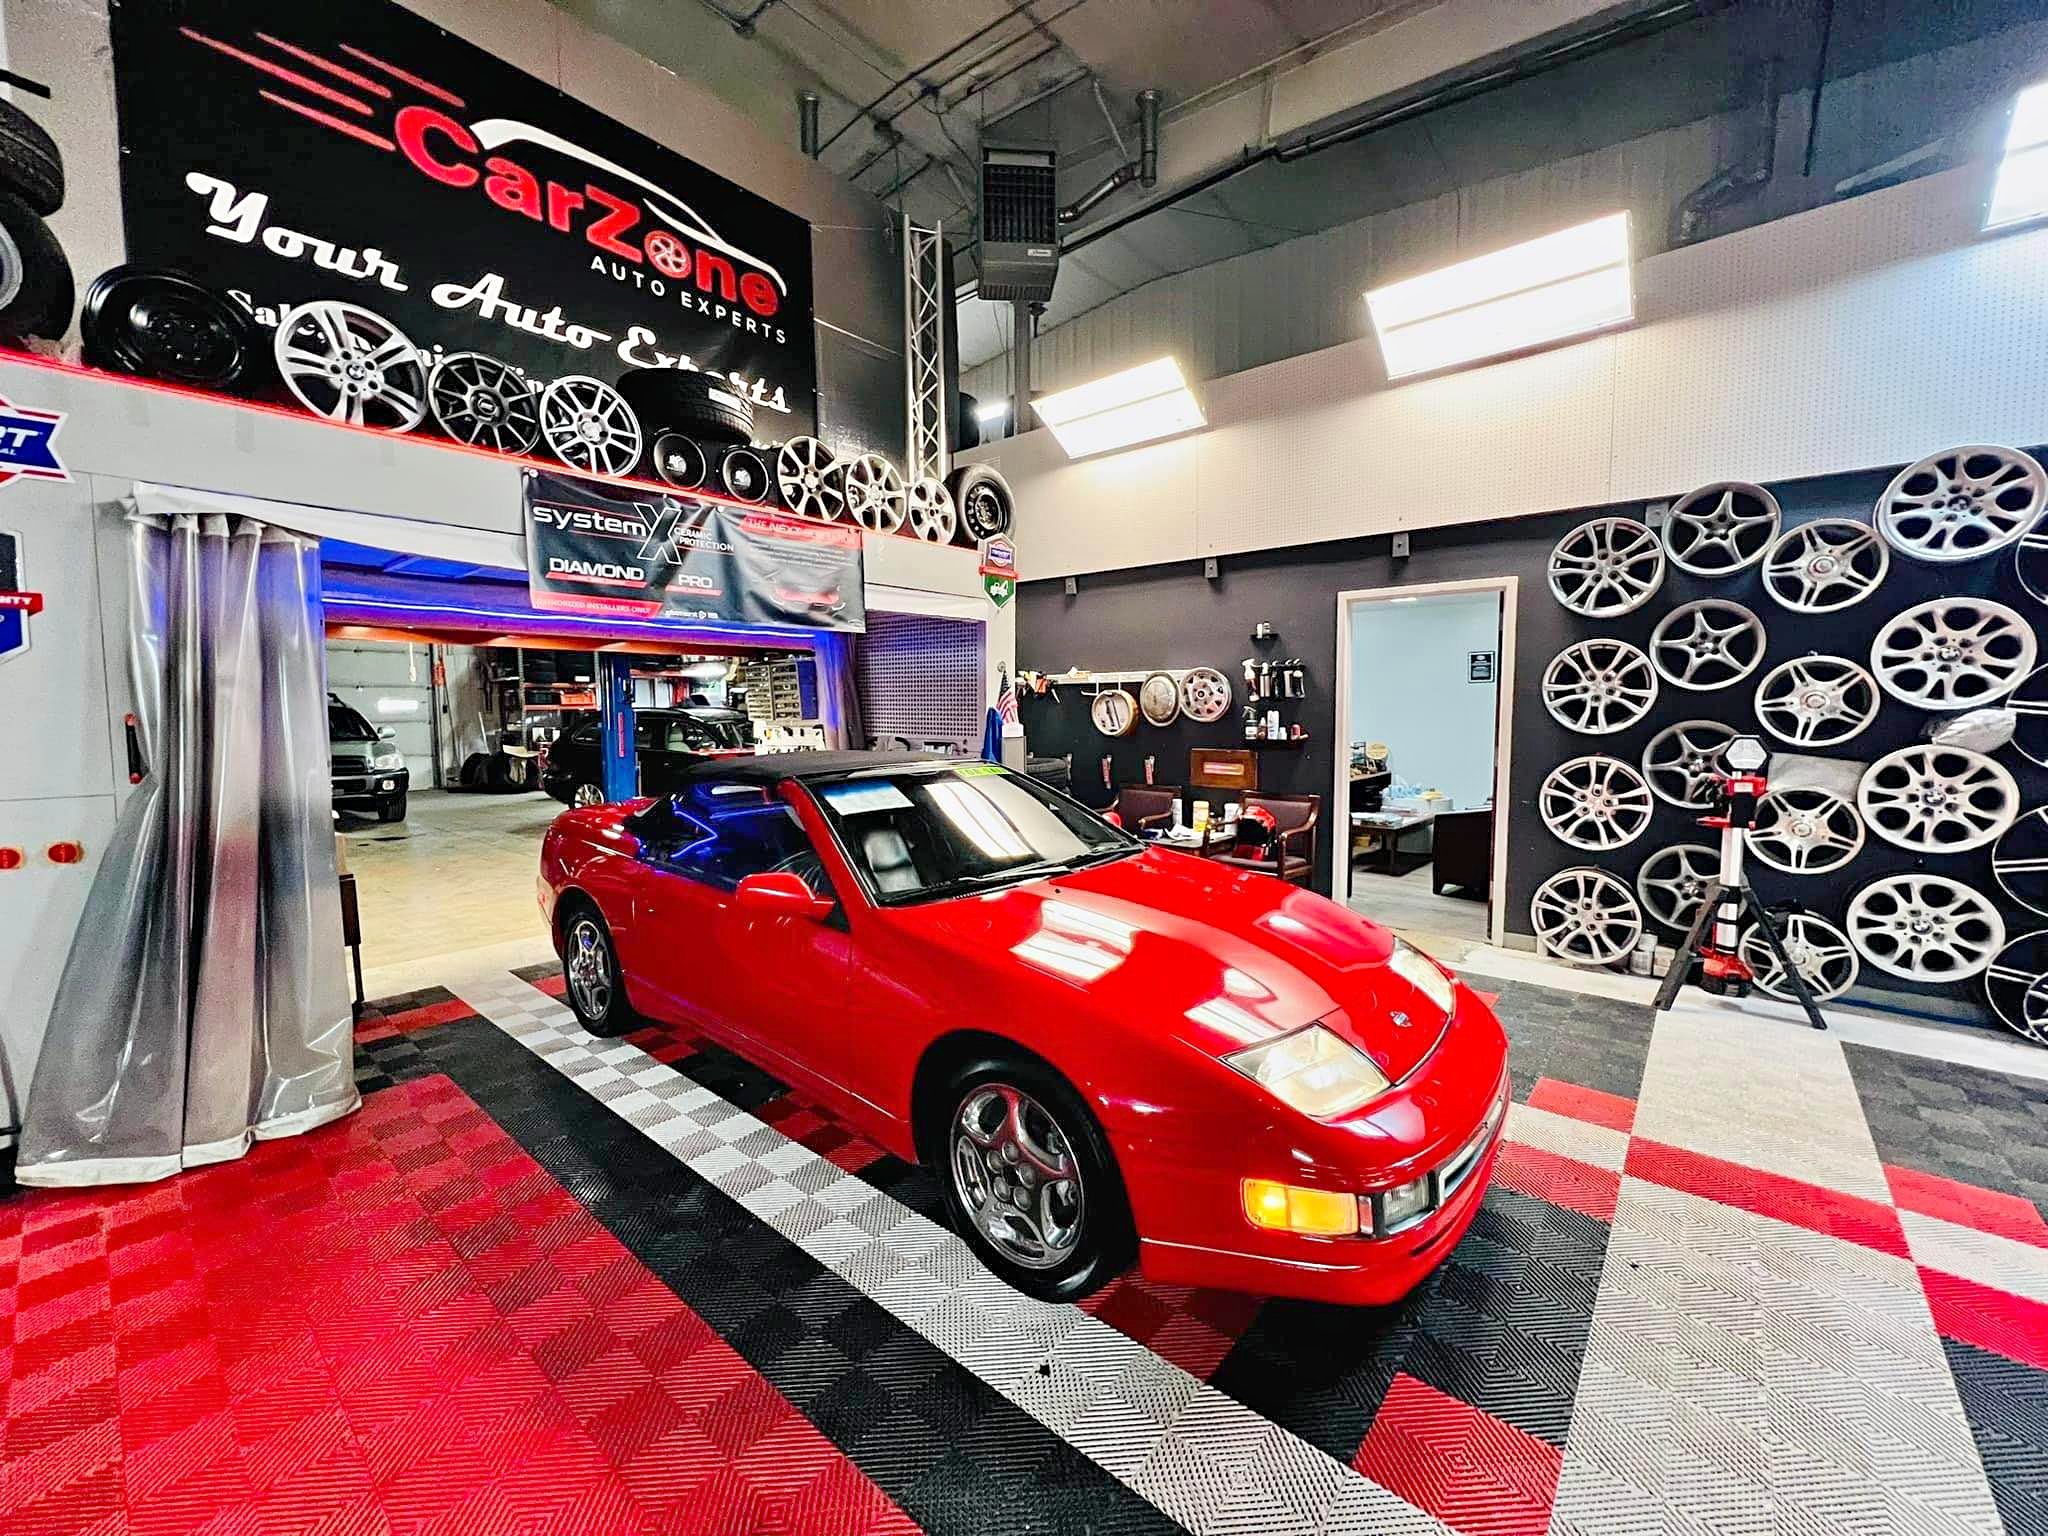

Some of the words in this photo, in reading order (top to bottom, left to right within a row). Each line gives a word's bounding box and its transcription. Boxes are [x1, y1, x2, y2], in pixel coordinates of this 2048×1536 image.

[395, 106, 779, 316] CarZone
[185, 172, 409, 291] Your
[431, 273, 611, 349] Auto
[591, 255, 665, 297] AUTO
[681, 291, 787, 344] EXPERTS
[674, 527, 712, 540] CERAMIC
[680, 536, 735, 551] PROTECTION
[549, 557, 644, 580] DIAMOND
[678, 574, 713, 588] PRO
